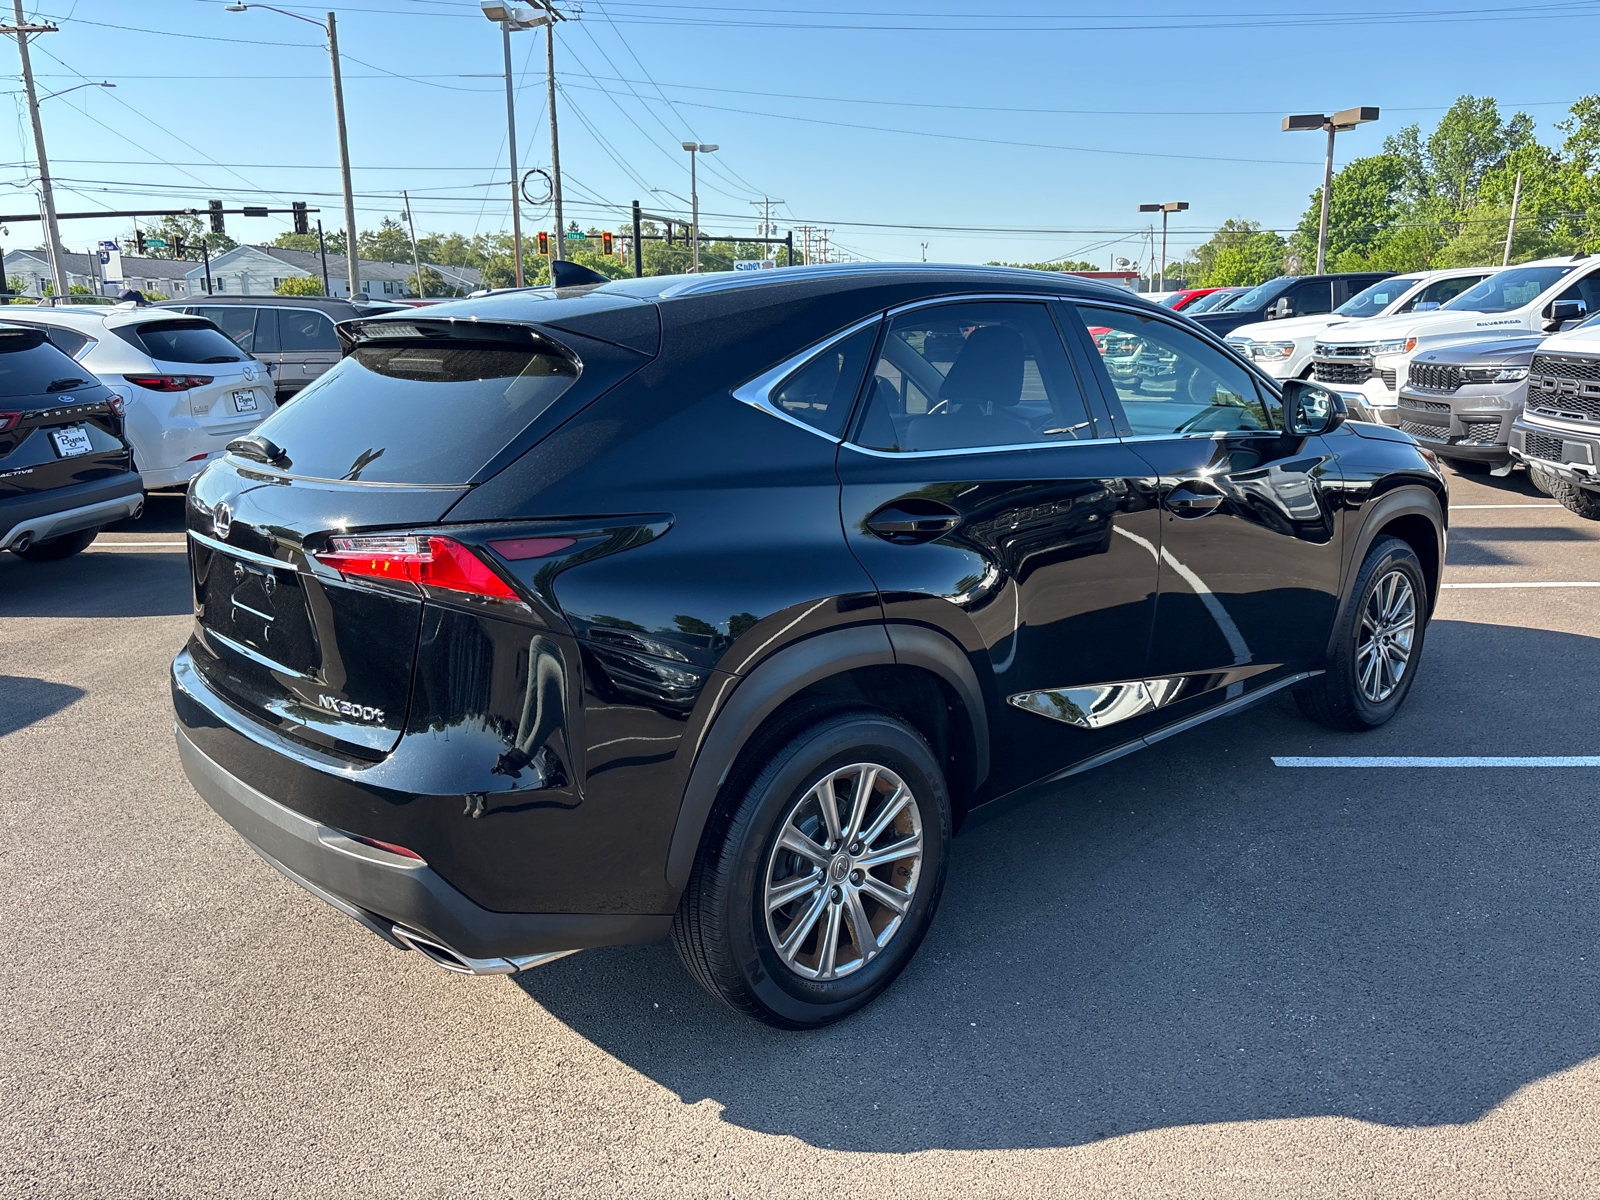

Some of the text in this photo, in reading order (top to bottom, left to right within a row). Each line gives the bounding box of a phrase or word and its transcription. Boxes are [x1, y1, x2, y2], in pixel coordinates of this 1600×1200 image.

[1476, 319, 1522, 327] SILVERADO
[1528, 373, 1600, 398] FORD
[43, 405, 101, 417] ESCAPE
[57, 434, 87, 448] Byers
[318, 694, 386, 723] NX200t
